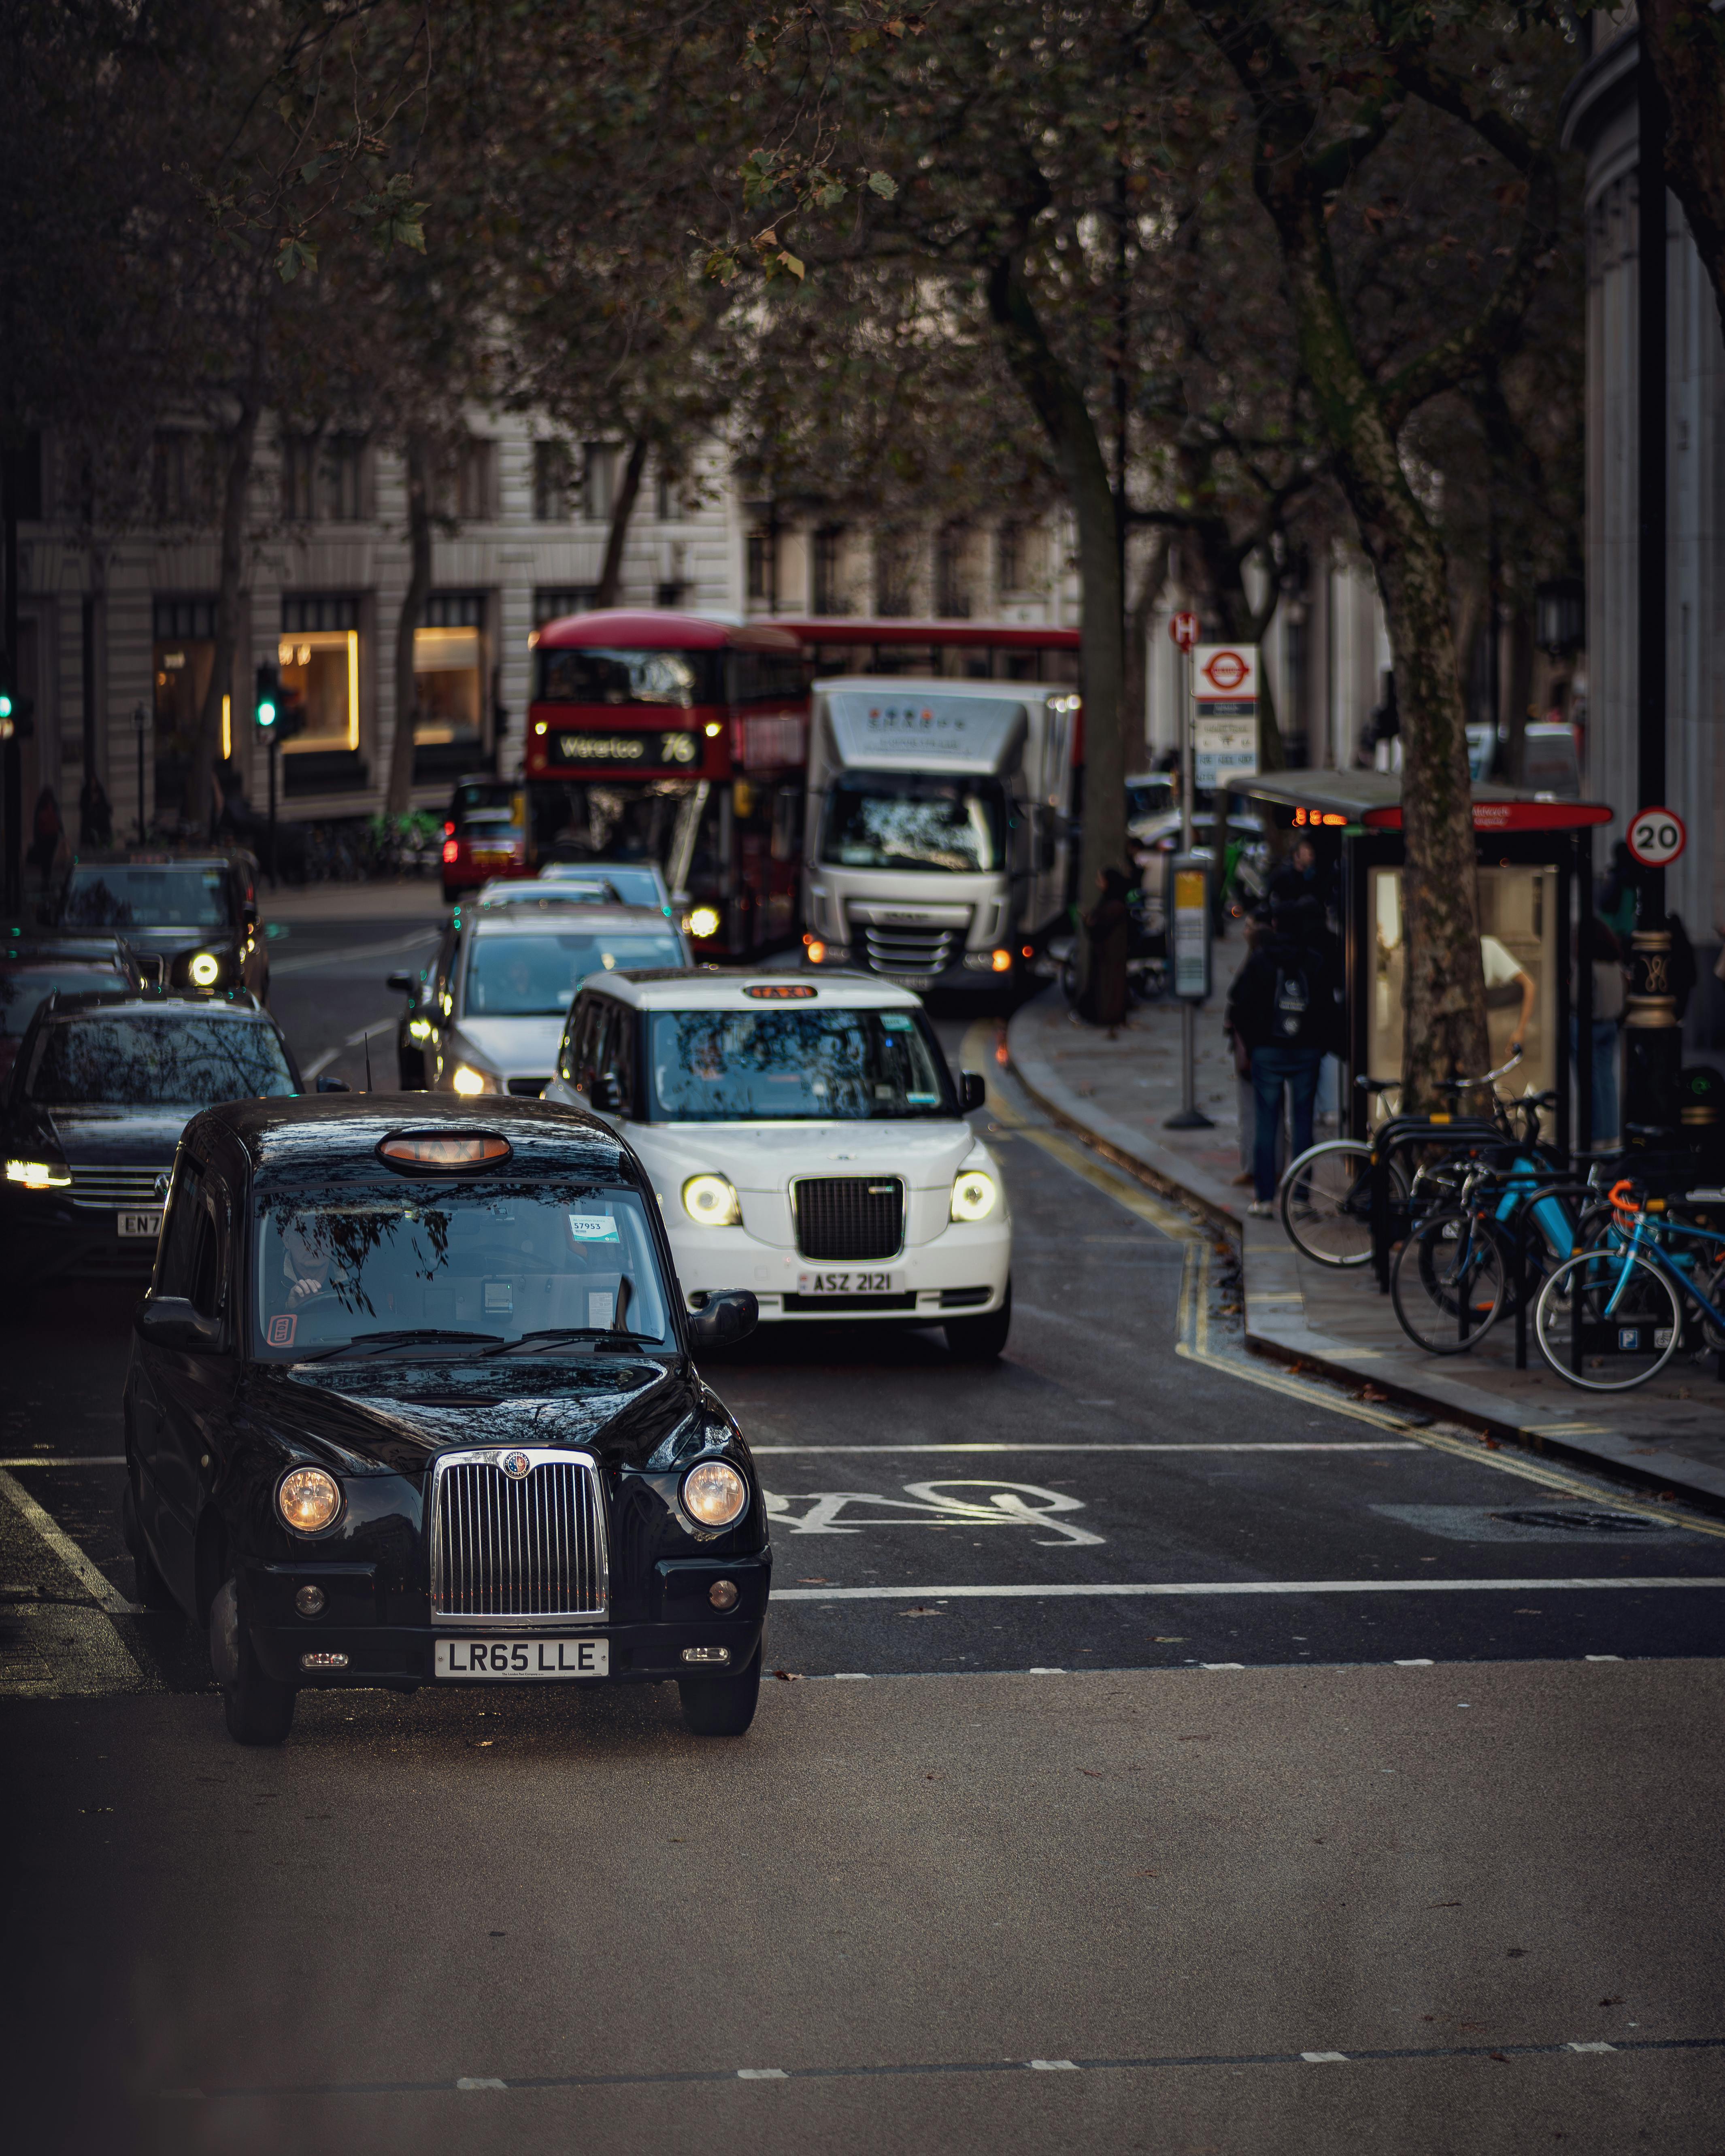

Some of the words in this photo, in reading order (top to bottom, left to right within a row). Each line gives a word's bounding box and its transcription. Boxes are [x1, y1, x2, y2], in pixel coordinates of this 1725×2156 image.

[1175, 616, 1196, 642] H
[661, 733, 695, 763] 76
[1636, 826, 1678, 849] 20
[408, 1138, 485, 1159] TAXI
[814, 1273, 849, 1291] ASZ
[856, 1273, 890, 1291] 2121
[276, 1320, 287, 1339] LTDA
[449, 1644, 528, 1671] LR65
[538, 1643, 595, 1671] LLE
